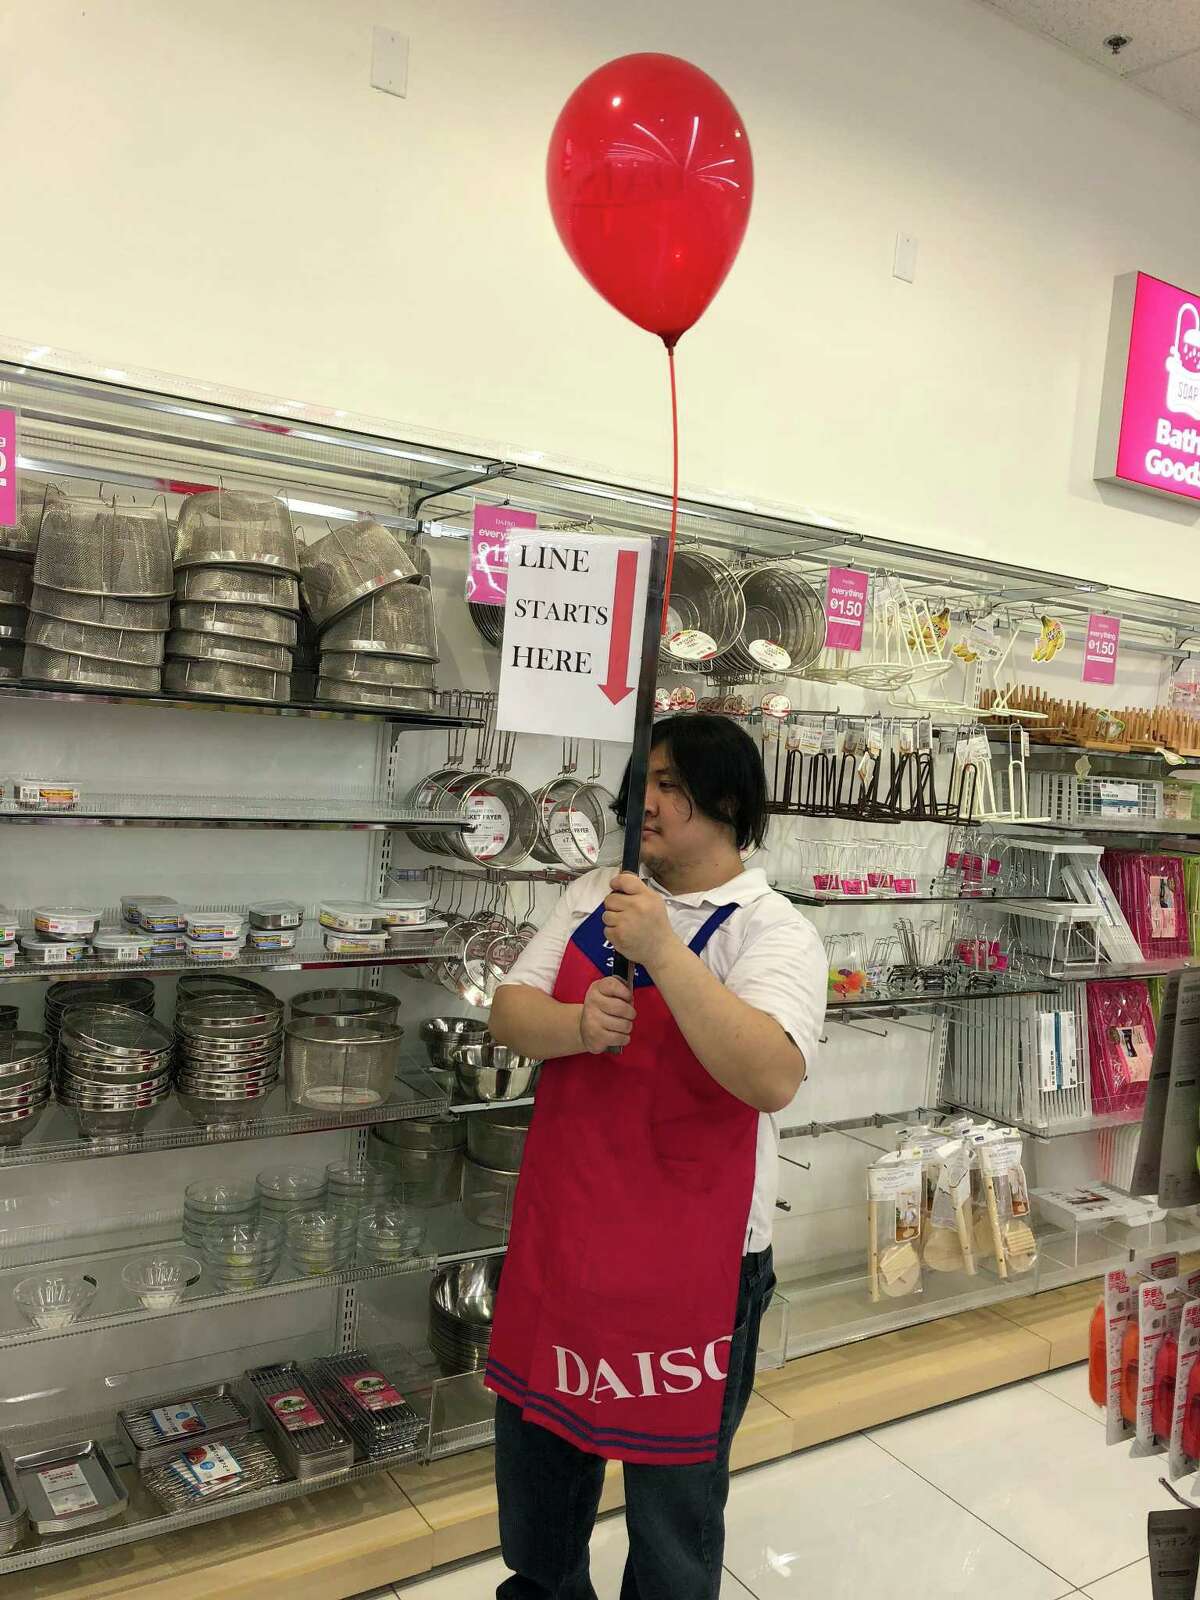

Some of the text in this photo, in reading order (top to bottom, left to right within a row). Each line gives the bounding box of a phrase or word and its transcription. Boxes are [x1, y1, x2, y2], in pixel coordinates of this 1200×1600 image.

[1145, 449, 1200, 488] Good
[519, 544, 590, 573] LINE
[831, 586, 864, 600] everything
[514, 598, 608, 626] STARTS
[830, 598, 862, 617] $1.50
[511, 645, 592, 674] HERE
